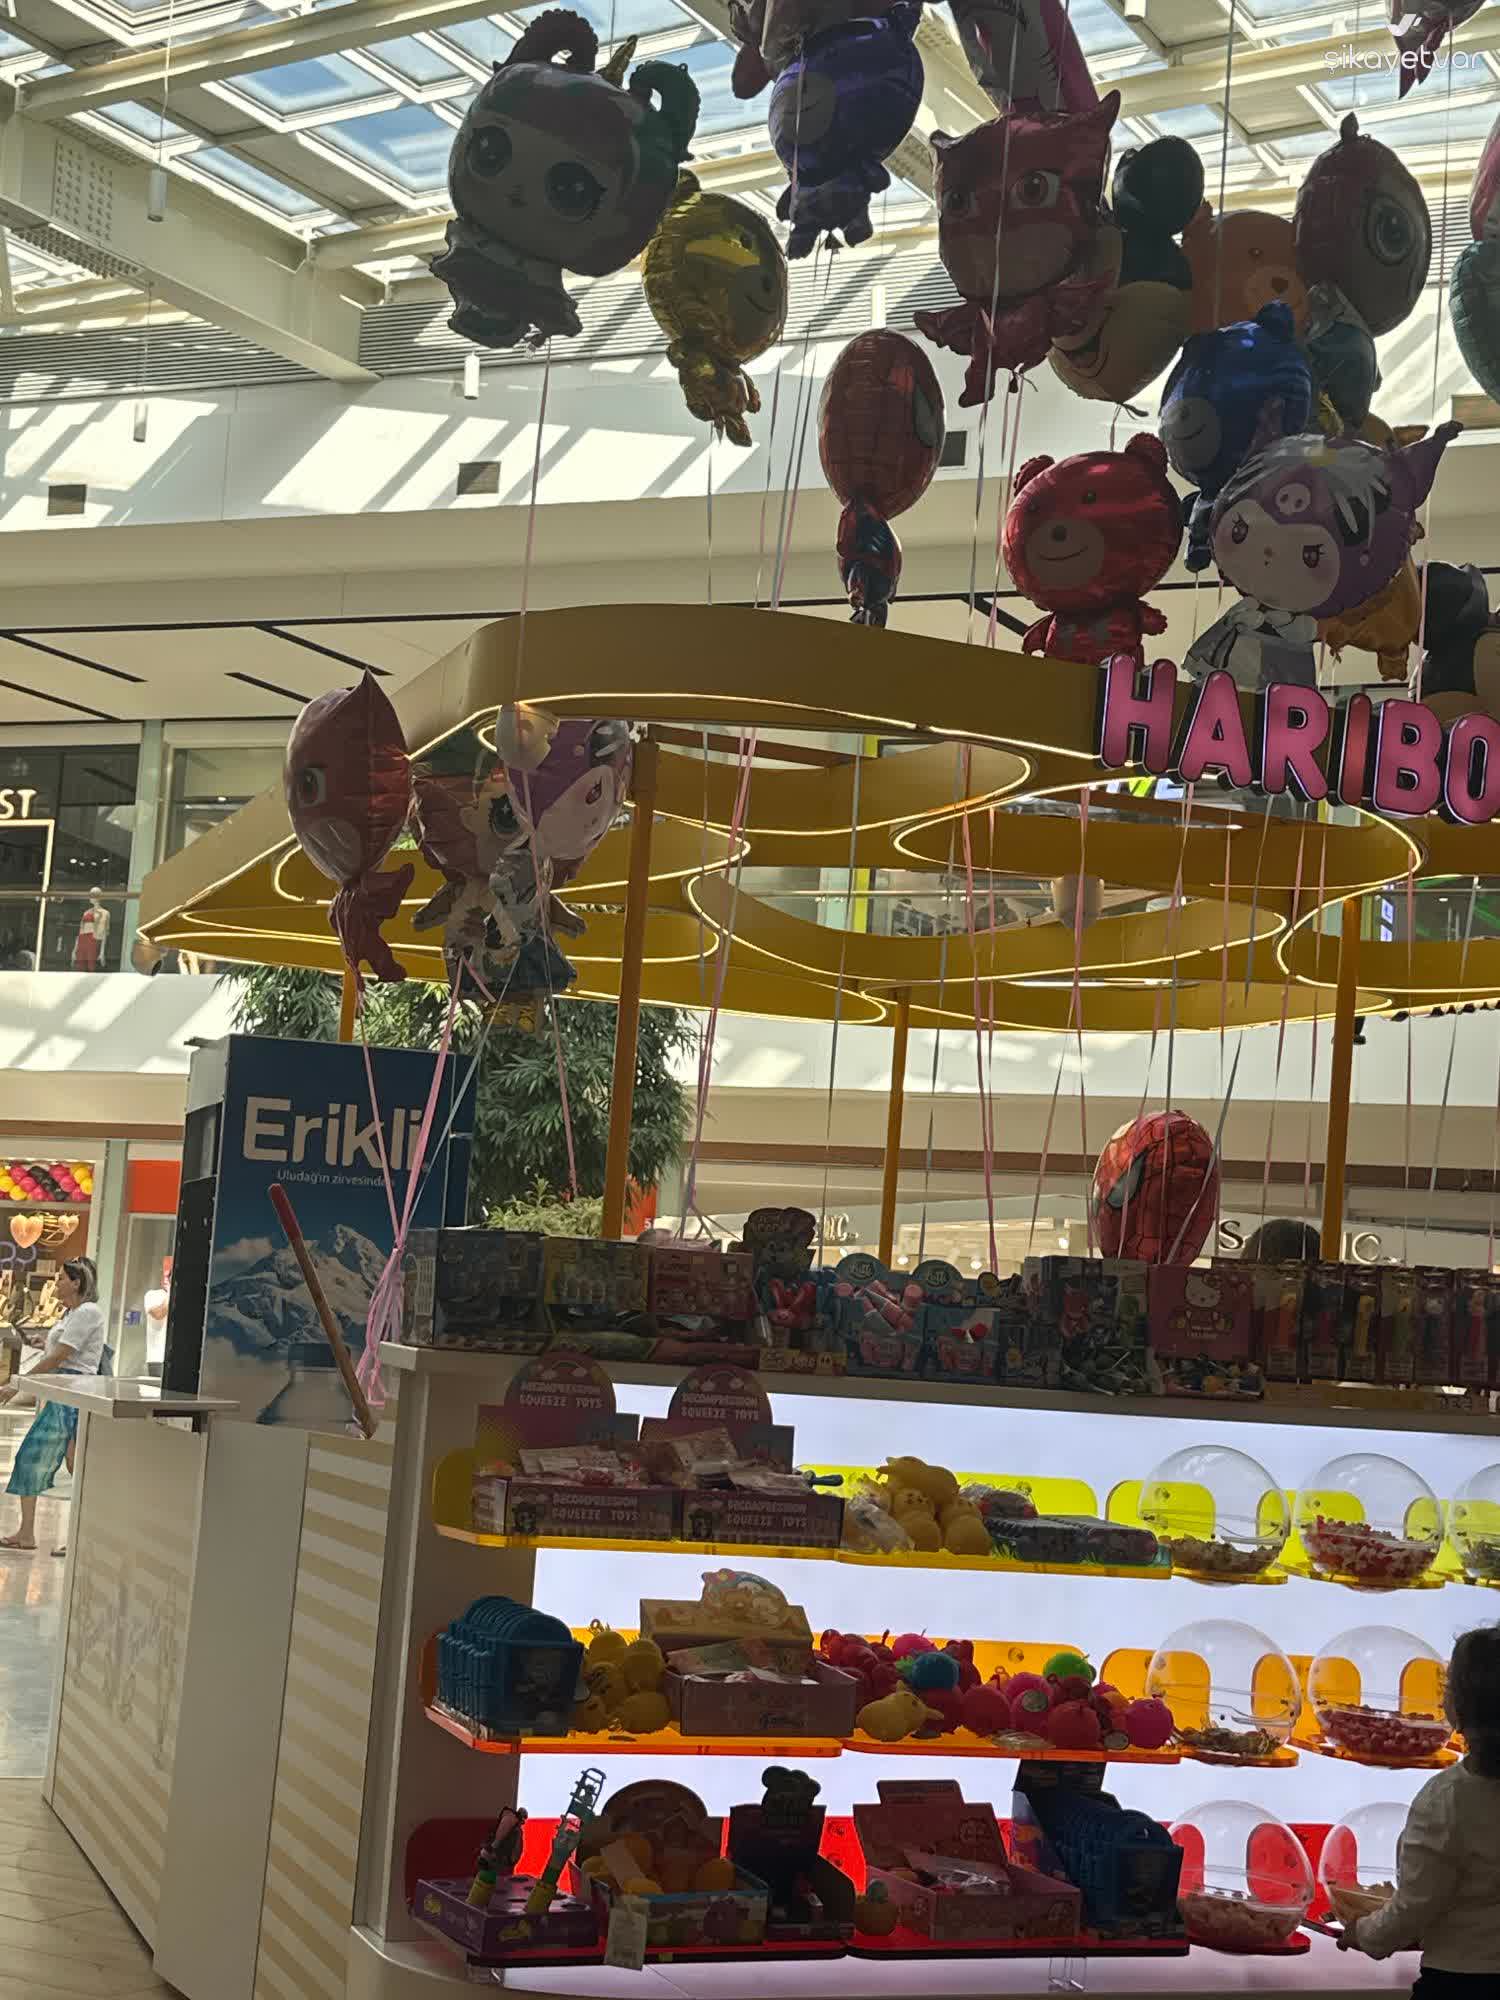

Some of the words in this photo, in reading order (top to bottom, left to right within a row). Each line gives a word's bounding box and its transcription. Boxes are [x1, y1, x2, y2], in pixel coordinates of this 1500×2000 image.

[1099, 652, 1500, 825] HARIBO
[243, 1095, 423, 1171] Erikli
[519, 1394, 567, 1408] SQUEEZE
[576, 1397, 603, 1410] TOYS
[681, 1406, 727, 1419] SQUEEZE
[735, 1409, 760, 1422] TOYS
[551, 1508, 601, 1521] SQUEEZE
[610, 1509, 639, 1522] TOYS
[726, 1513, 773, 1527] SQUEEZE
[780, 1515, 808, 1529] TOYS
